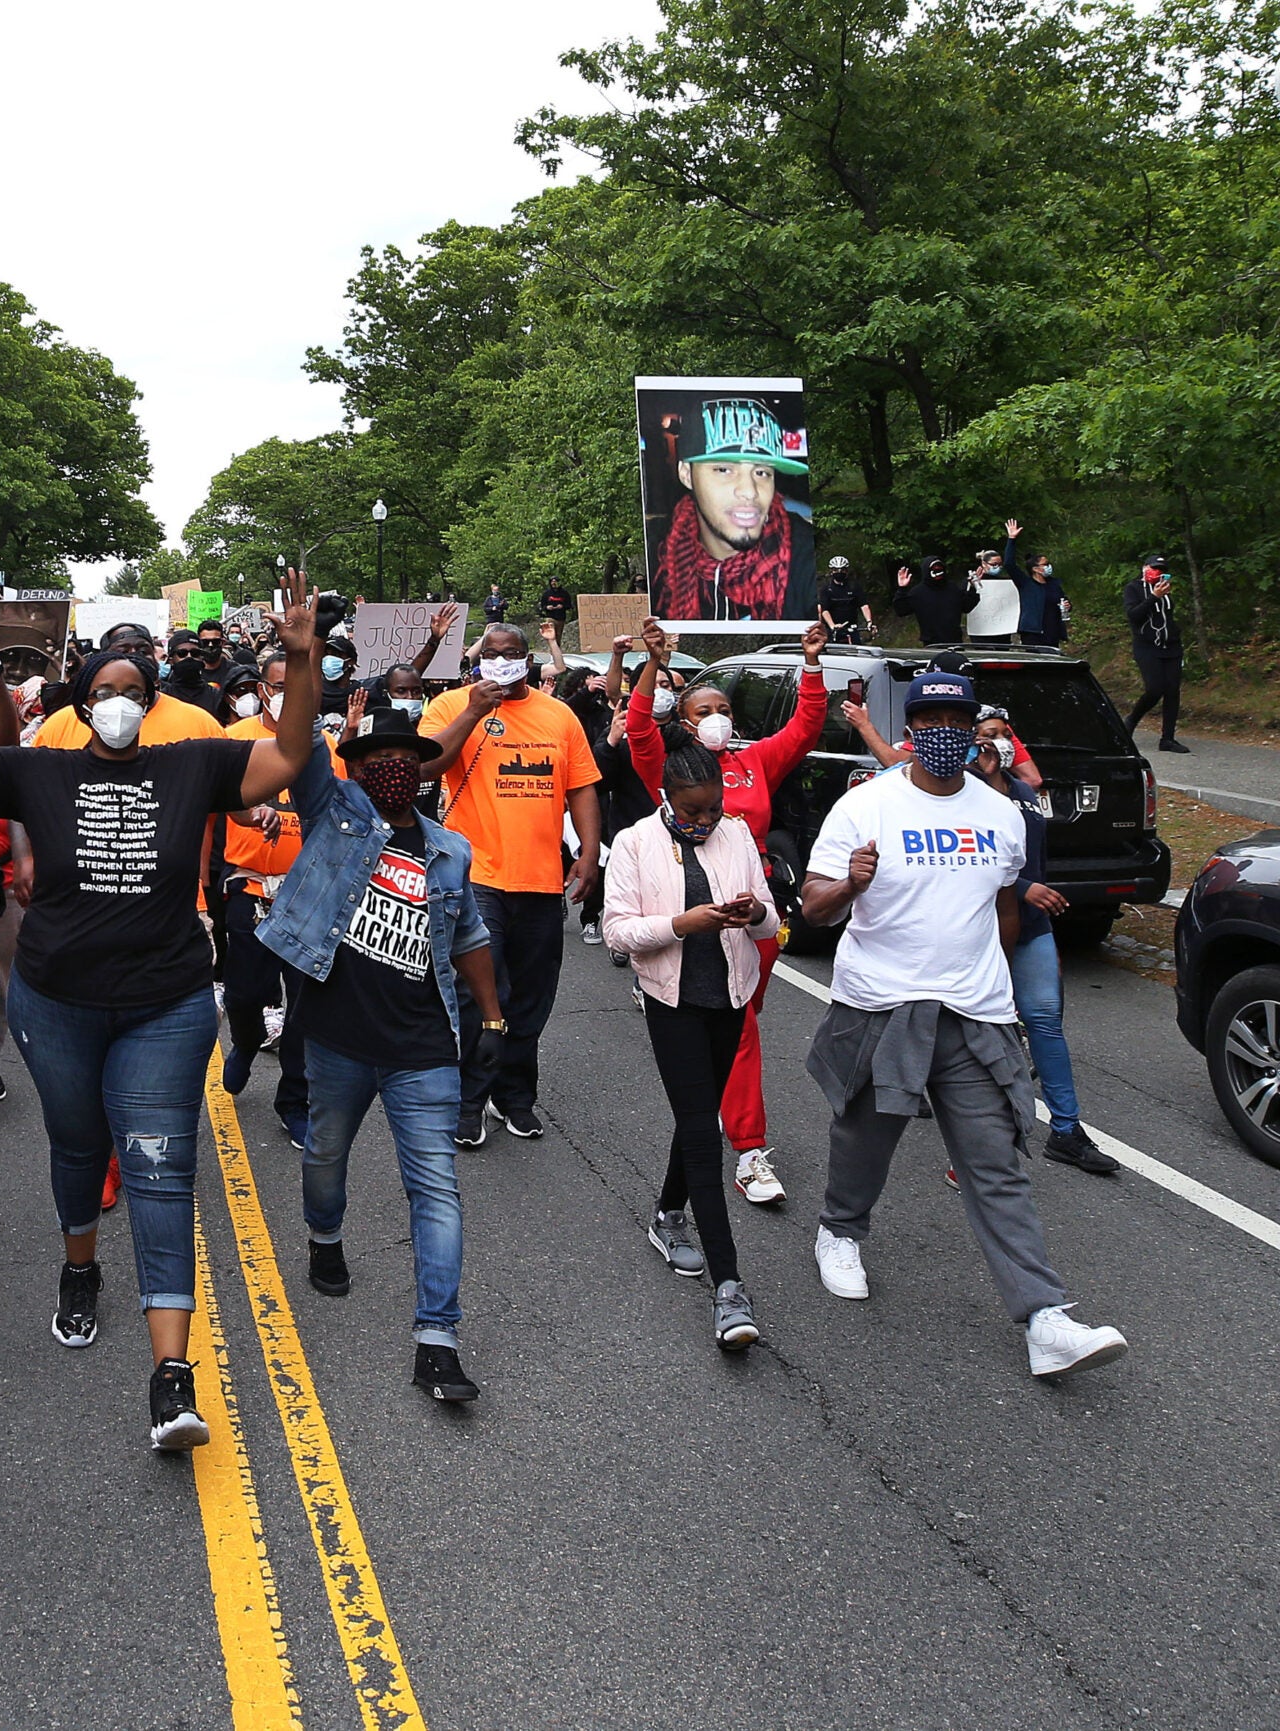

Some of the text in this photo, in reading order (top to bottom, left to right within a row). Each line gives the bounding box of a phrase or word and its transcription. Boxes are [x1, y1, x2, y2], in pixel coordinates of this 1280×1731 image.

[394, 606, 426, 626] NO
[364, 626, 456, 648] JUSTIE
[389, 645, 416, 660] NO
[922, 684, 964, 696] BOSTON
[495, 779, 554, 790] Violence In Bosto
[122, 811, 148, 820] FLOYD
[123, 821, 157, 830] TAYLOR
[86, 840, 148, 850] ERIC GARNER
[902, 828, 998, 854] BIDEN
[75, 849, 117, 859] ANDREW
[77, 860, 157, 870] STEPHEN CLARK
[906, 856, 998, 866] PRESIDENT
[91, 873, 143, 882] TAMIR RICE
[373, 859, 427, 899] ANGER
[79, 883, 151, 894] SANDRA BLAND
[347, 915, 430, 969] ACKMAN
